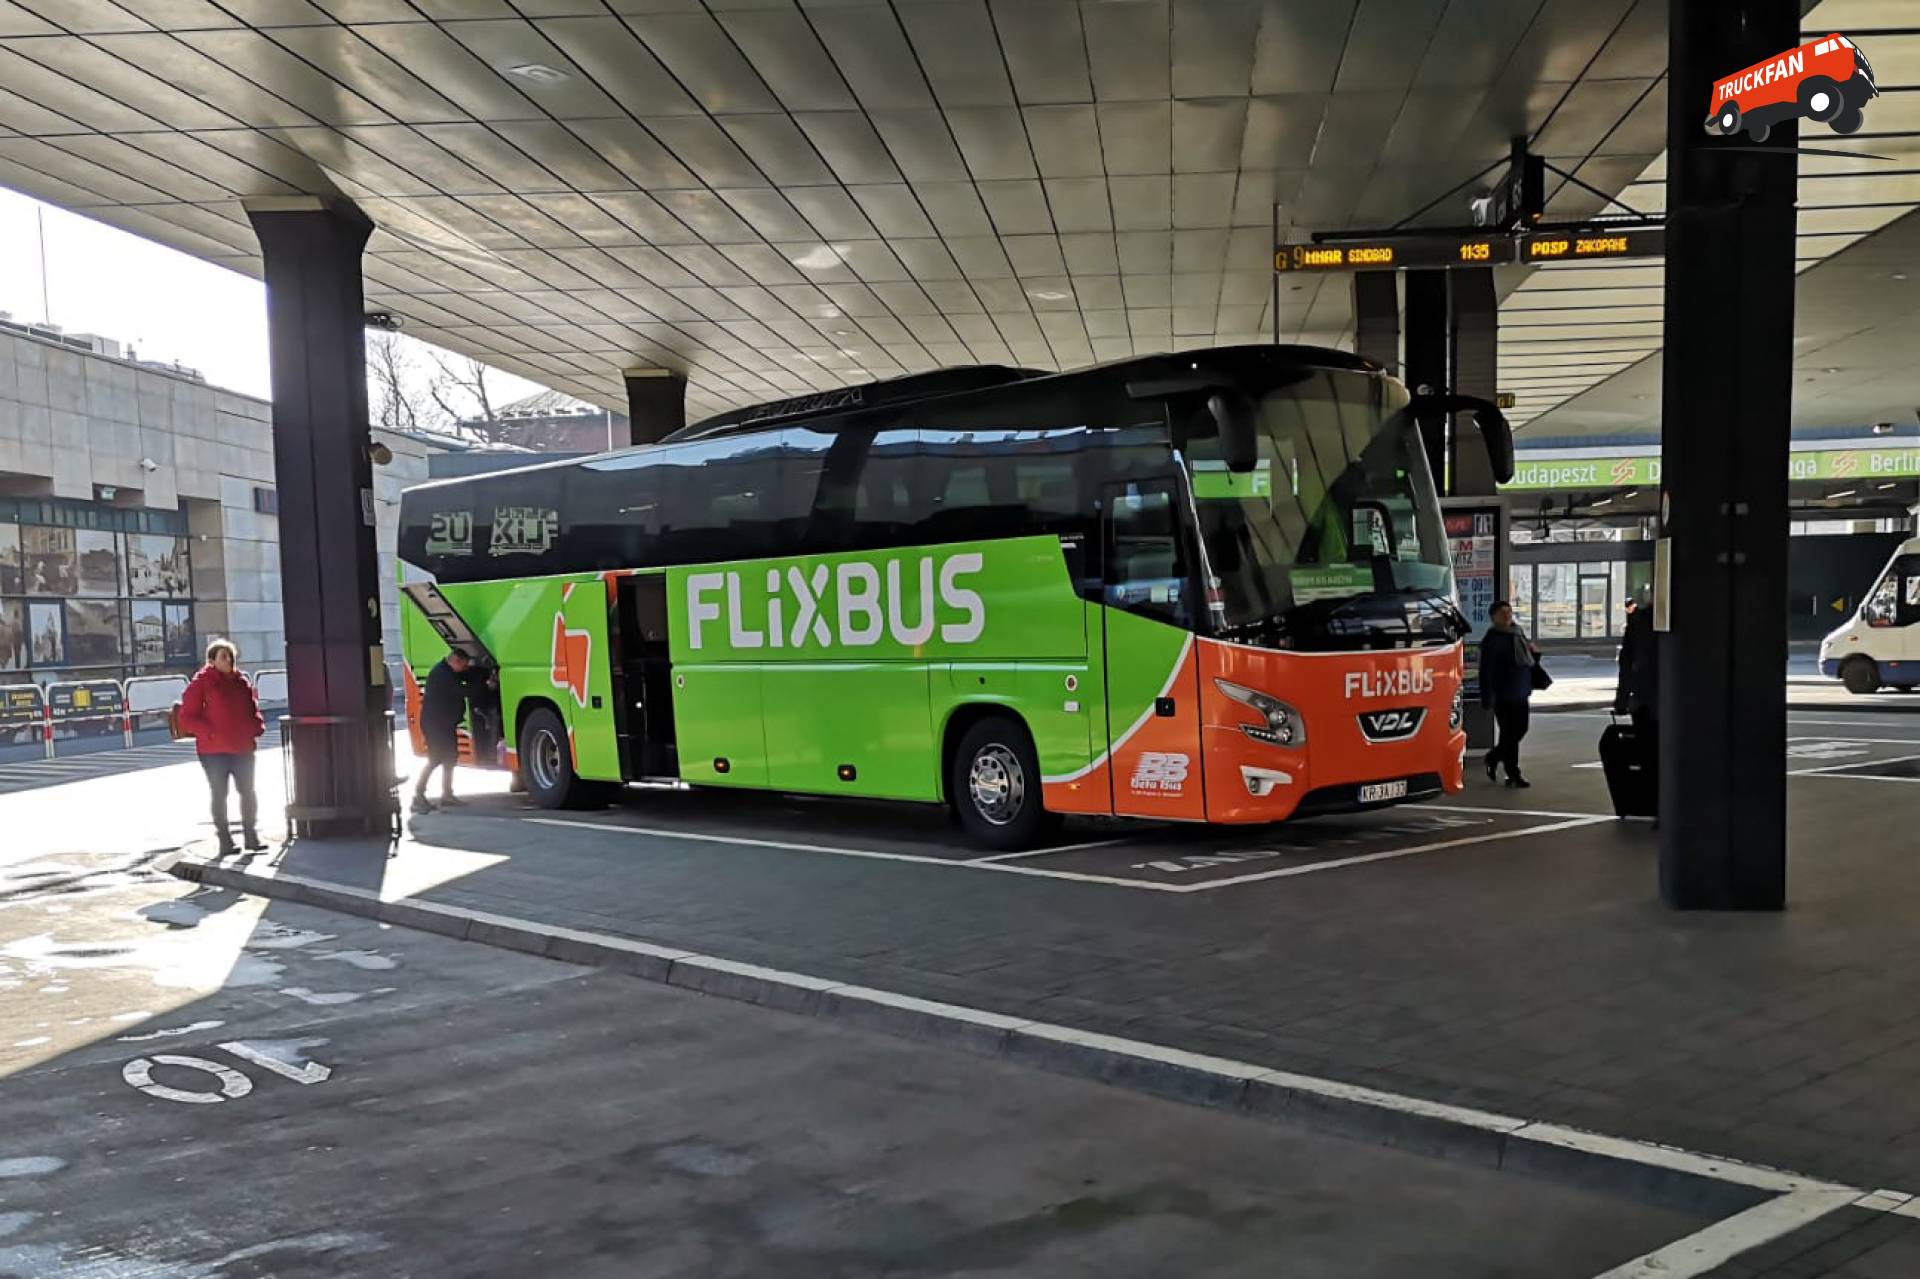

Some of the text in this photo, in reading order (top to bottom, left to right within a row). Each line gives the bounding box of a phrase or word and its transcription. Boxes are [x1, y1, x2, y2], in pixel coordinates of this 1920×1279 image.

[1531, 241, 1569, 256] POSP
[1509, 463, 1597, 487] udapeszt
[687, 552, 986, 649] FLiXBUS
[1345, 668, 1435, 699] FLiXBUS
[1367, 712, 1413, 731] VDL
